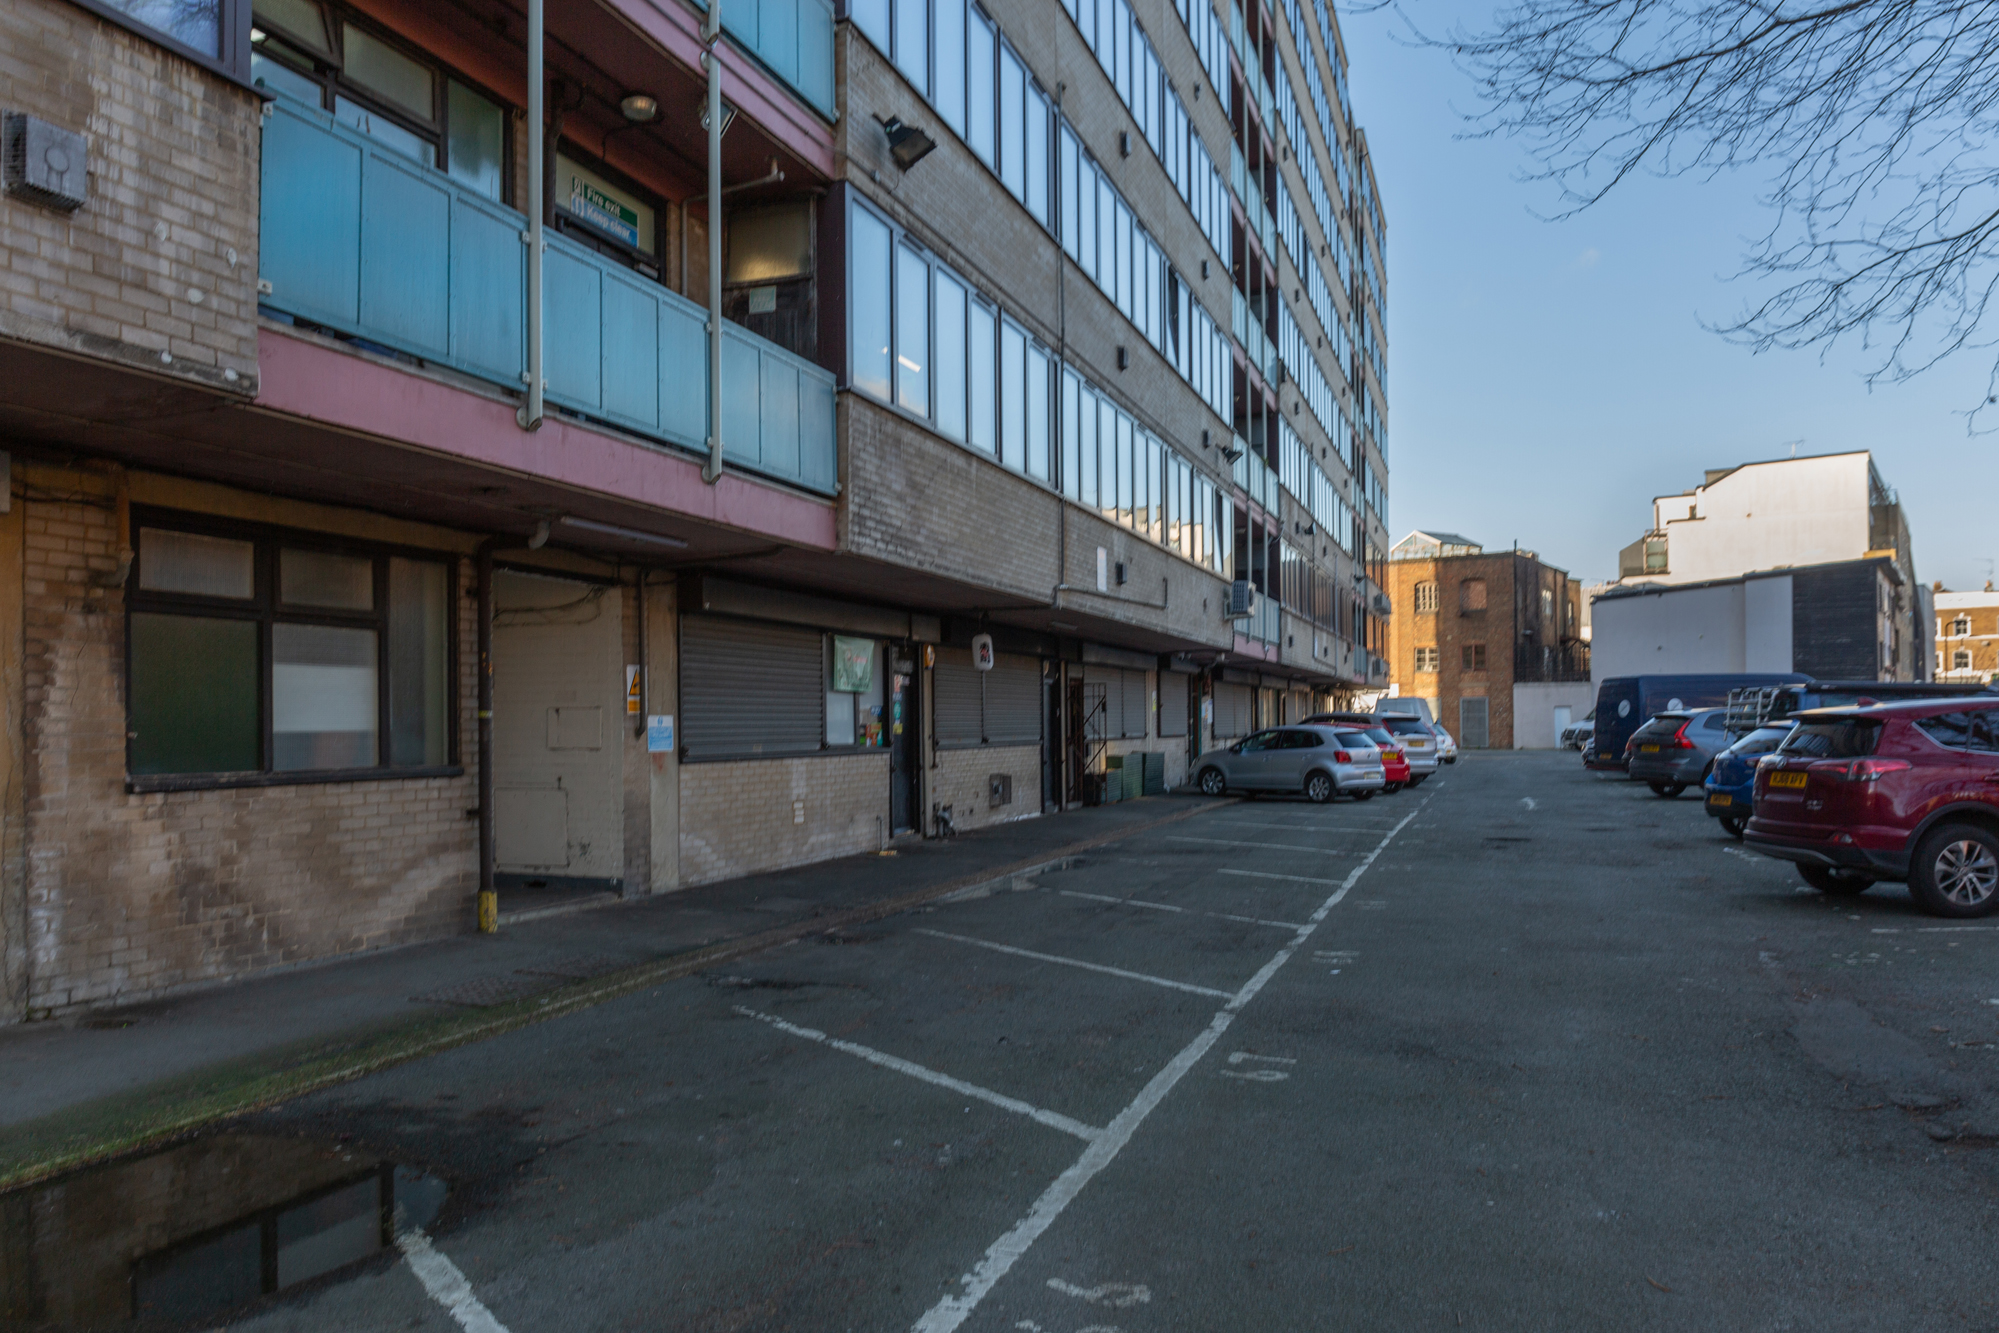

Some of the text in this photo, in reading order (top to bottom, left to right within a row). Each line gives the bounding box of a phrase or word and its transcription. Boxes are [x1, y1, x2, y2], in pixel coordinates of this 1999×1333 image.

[587, 187, 620, 218] Fire exit
[587, 204, 630, 239] Keep clear
